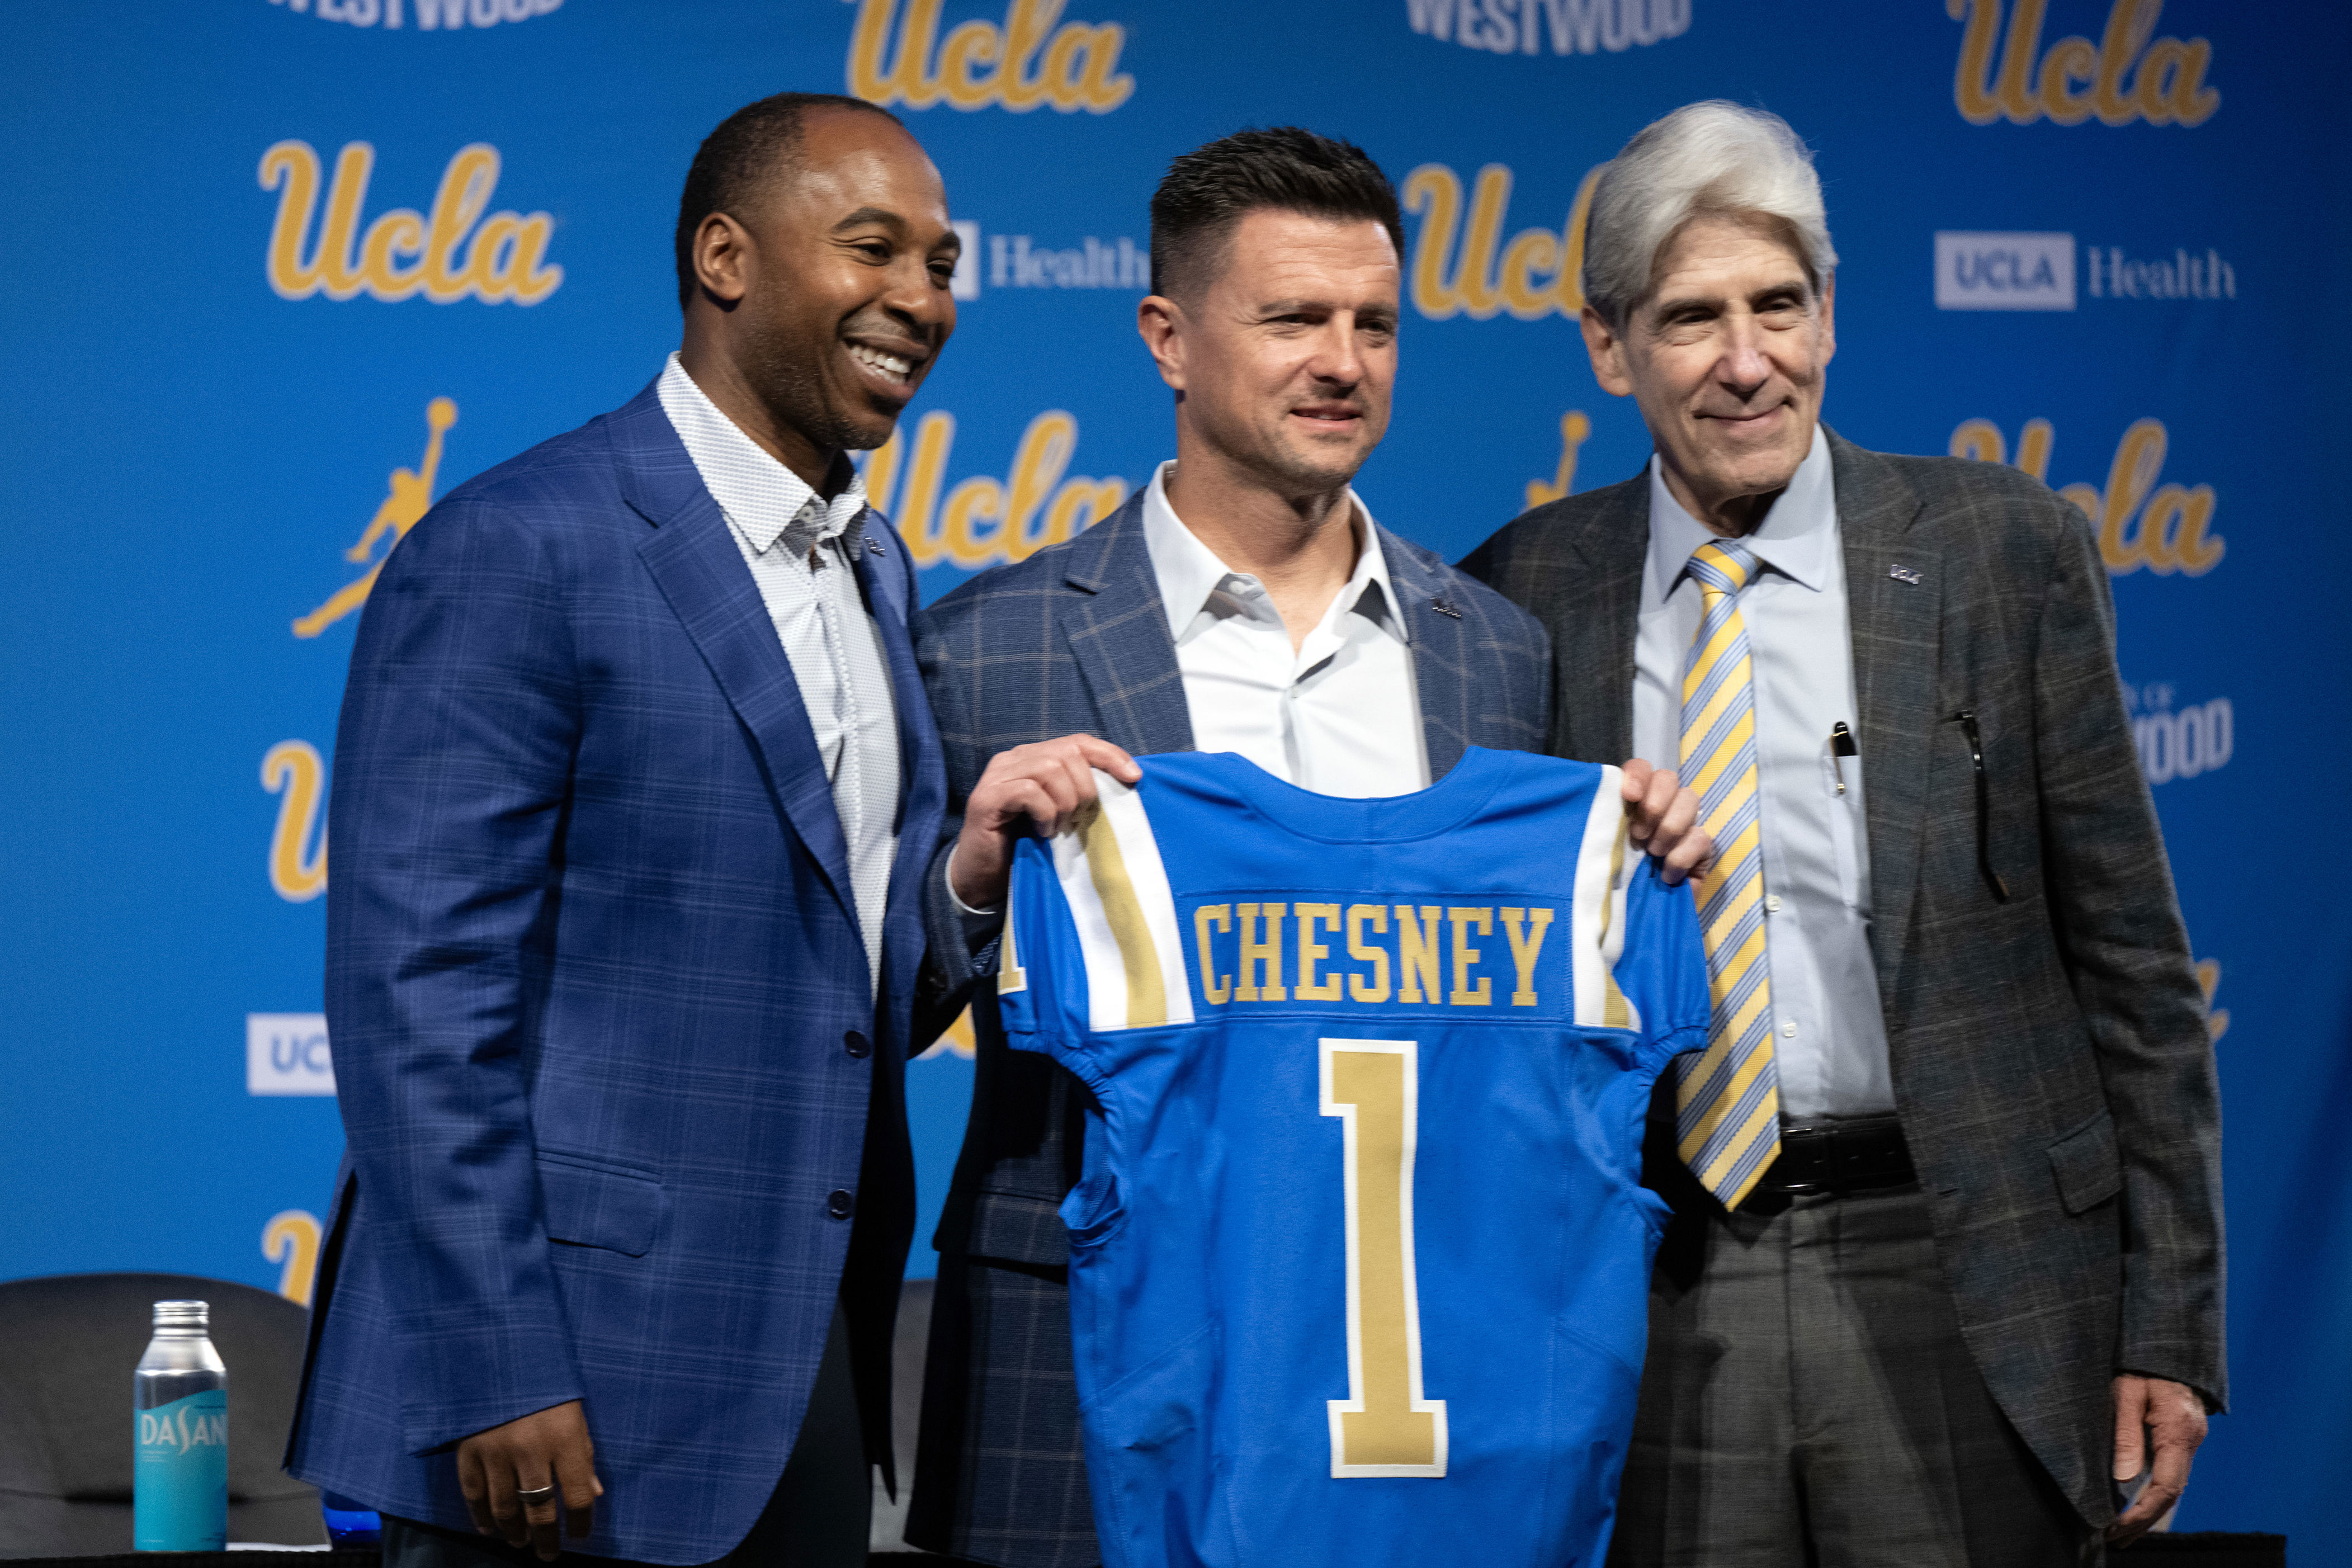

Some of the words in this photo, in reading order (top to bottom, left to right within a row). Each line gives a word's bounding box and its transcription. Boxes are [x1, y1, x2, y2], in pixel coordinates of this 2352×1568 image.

[846, 0, 1136, 114] Ucla
[1945, 0, 2222, 128] Ucla
[257, 139, 564, 306] Ucla
[988, 234, 1152, 288] Health
[1402, 162, 1604, 321] Ucl
[1954, 248, 2057, 292] UCLA
[2086, 245, 2236, 300] Health
[1193, 902, 1554, 1007] CHESNEY
[270, 1033, 331, 1075] UC
[1318, 1037, 1449, 1479] 1
[140, 1404, 228, 1456] DASAN
